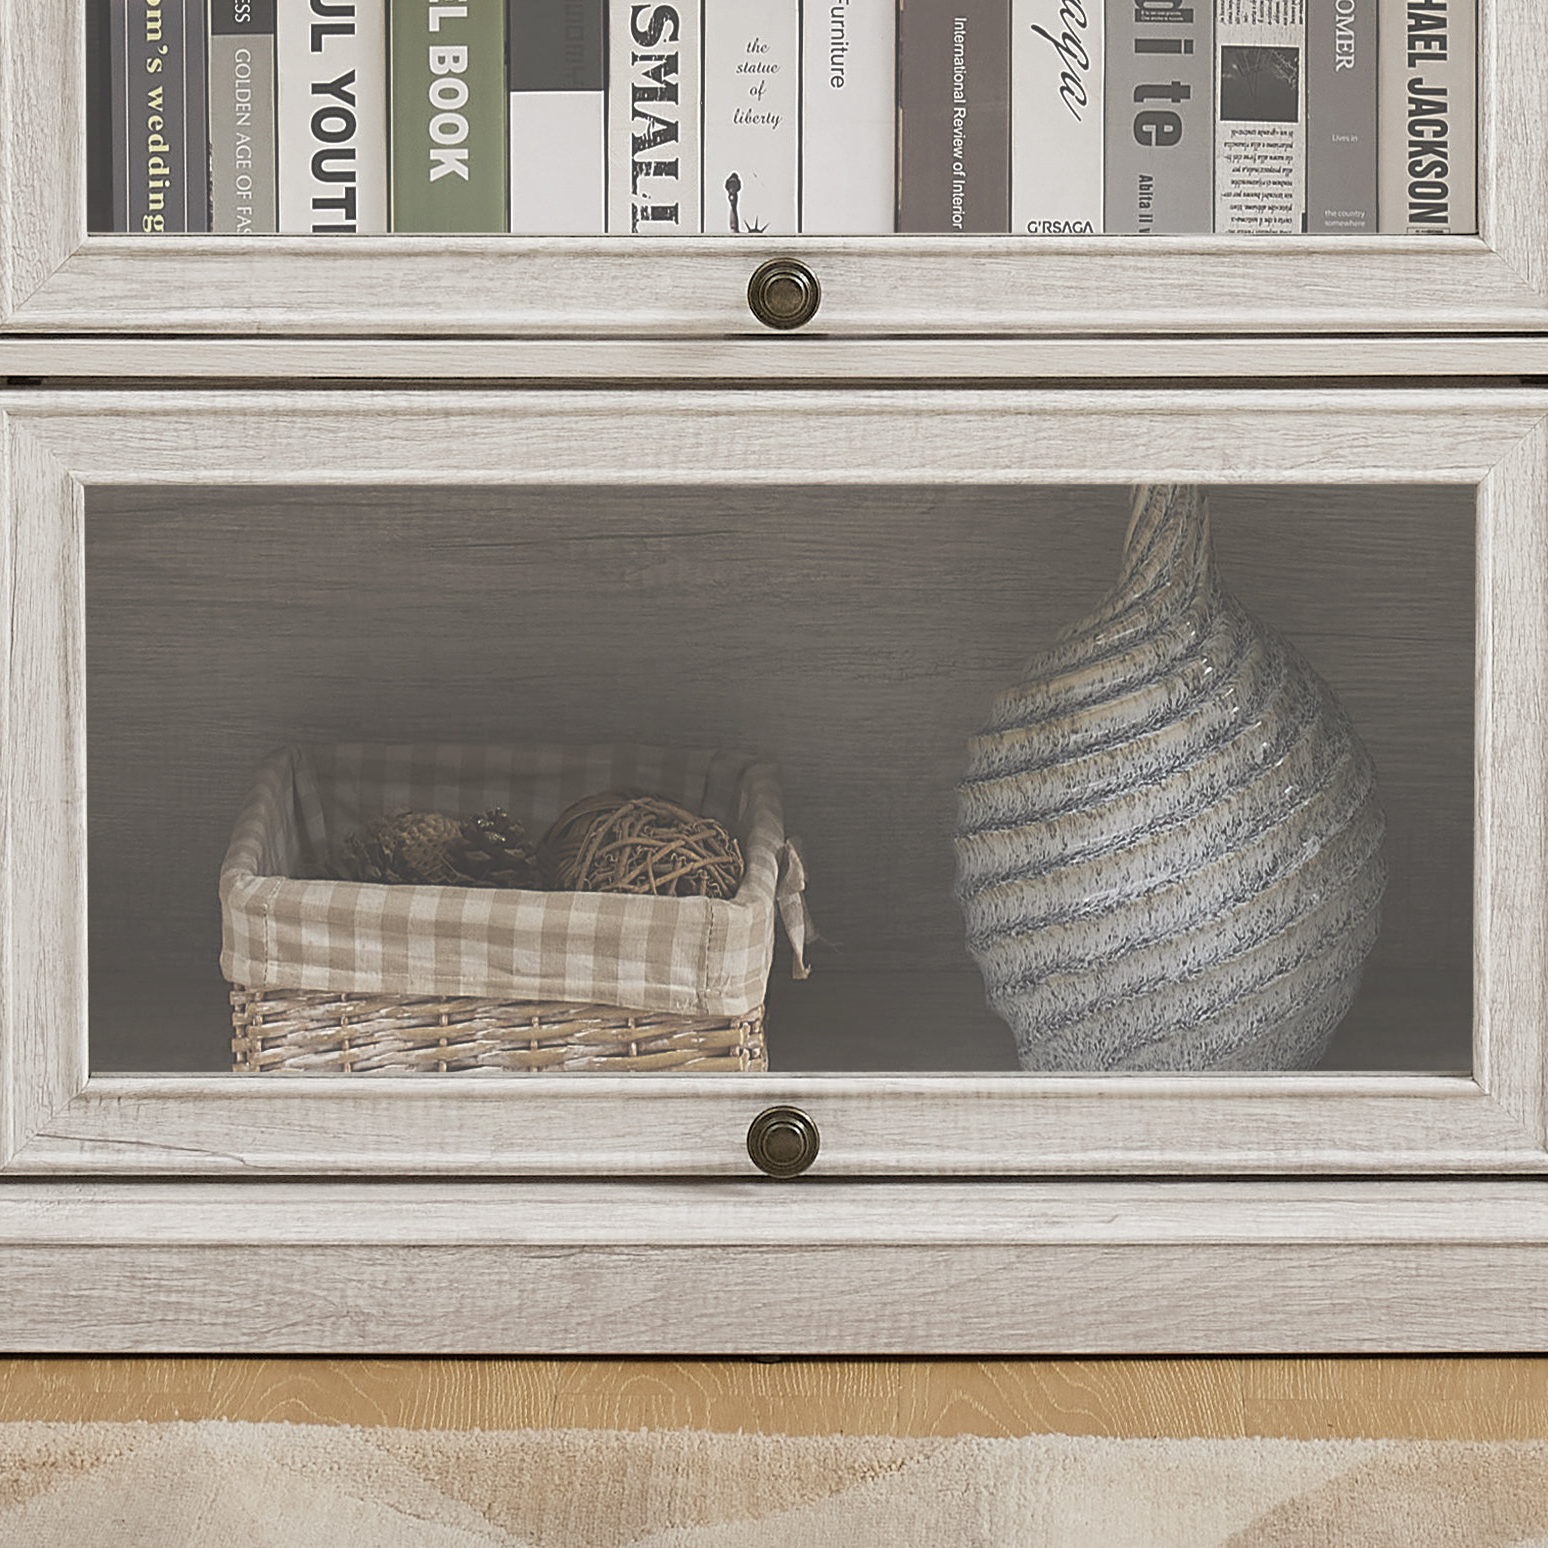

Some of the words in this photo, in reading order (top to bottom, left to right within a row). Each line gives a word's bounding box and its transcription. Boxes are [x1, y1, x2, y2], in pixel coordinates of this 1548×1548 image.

[746, 37, 770, 53] the
[954, 18, 966, 102] International
[736, 62, 780, 73] statue
[235, 48, 252, 126] GOLDEN
[749, 80, 767, 101] of
[429, 46, 468, 181] BOOK
[733, 108, 782, 130] liberty
[1132, 80, 1193, 149] te
[235, 132, 252, 169] AGE
[953, 107, 967, 159] Review
[1332, 134, 1350, 142] Lives
[1351, 134, 1358, 142] in
[1406, 76, 1449, 224] JACKSON
[141, 85, 171, 232] wedding
[952, 161, 966, 176] of
[236, 174, 252, 199] OF
[952, 180, 966, 229] Interior
[1338, 210, 1365, 219] country
